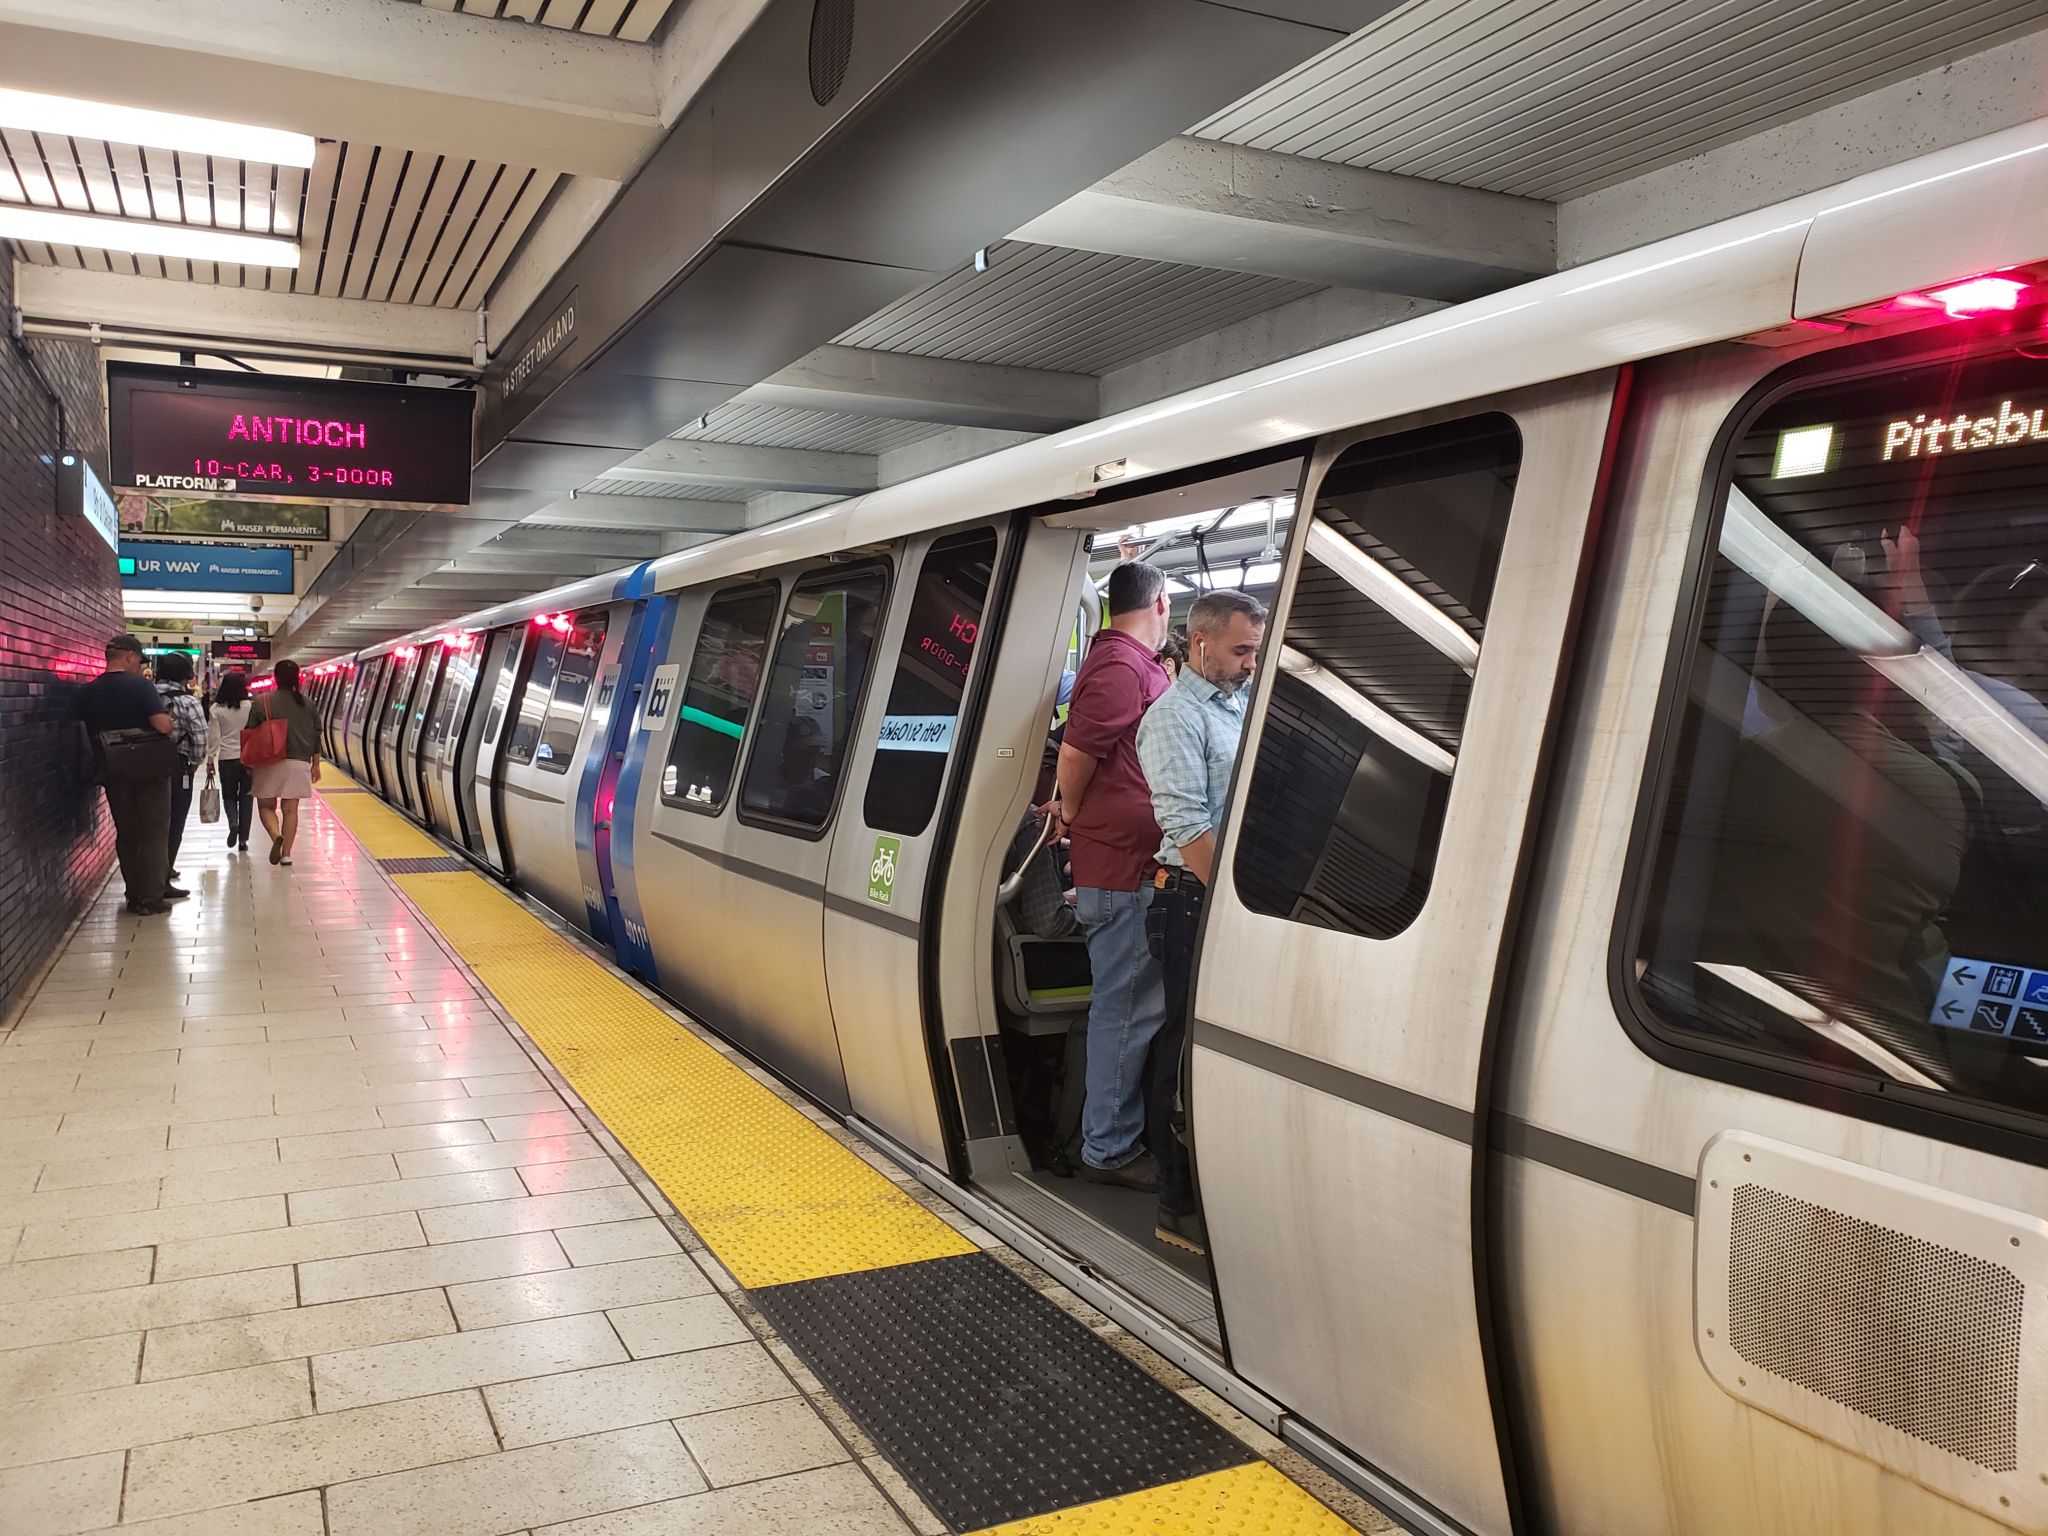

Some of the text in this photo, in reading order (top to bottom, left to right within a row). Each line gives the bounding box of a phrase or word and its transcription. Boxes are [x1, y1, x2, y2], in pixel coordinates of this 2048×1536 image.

[510, 348, 535, 391] STREET
[536, 307, 575, 362] OAKLAND
[227, 414, 366, 448] ANTIOCH
[194, 457, 393, 486] 10-CAR, 3-DOOR
[135, 474, 217, 491] PLATFORM
[236, 524, 318, 535] KAISER PERMANENTE
[165, 560, 200, 573] WAY
[220, 566, 240, 574] KAISER
